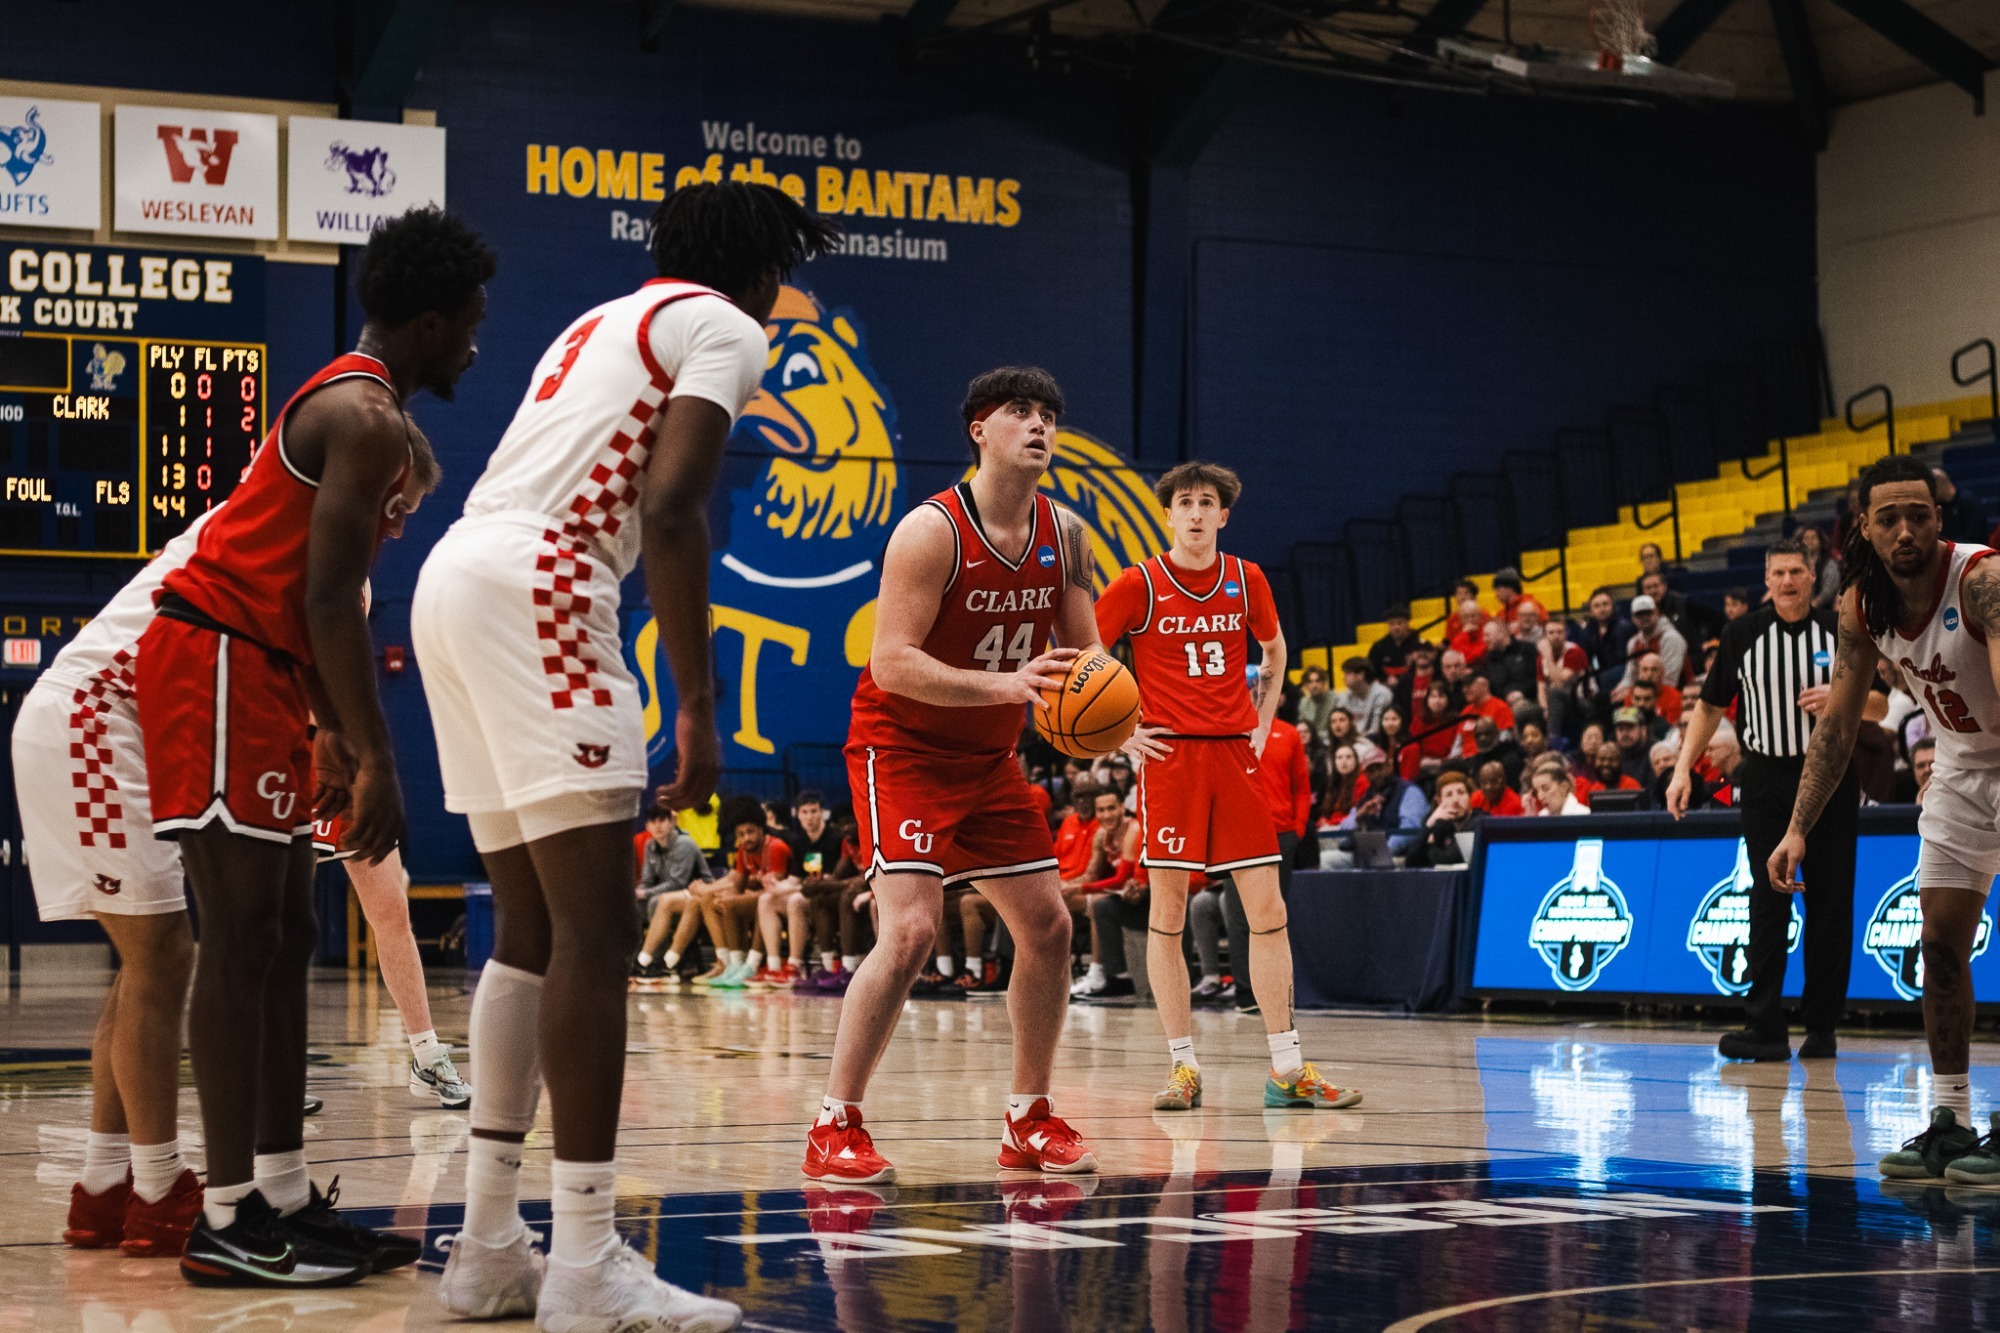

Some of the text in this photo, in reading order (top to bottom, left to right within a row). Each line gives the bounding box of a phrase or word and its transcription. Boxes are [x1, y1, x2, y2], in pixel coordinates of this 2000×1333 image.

[702, 120, 862, 160] Welcome to
[526, 144, 665, 201] HOME
[816, 166, 1021, 227] BANTAMS
[0, 193, 49, 216] UFTS
[142, 200, 255, 226] WESLEYAN
[317, 210, 387, 238] WILLIA
[9, 248, 233, 303] COLLEGE
[34, 298, 138, 330] COURT
[150, 345, 259, 372] PLY FL PTS
[535, 314, 604, 402] 3
[171, 372, 255, 402] 0 0 0
[53, 395, 110, 421] CLARK
[241, 405, 255, 432] 2
[6, 477, 130, 505] FOUL FLS
[162, 463, 212, 491] 13 0
[152, 494, 186, 518] 44
[965, 585, 1056, 613] CLARK
[1158, 612, 1242, 635] CLARK
[11, 640, 37, 662] EXIT
[972, 622, 1036, 672] 44
[1183, 640, 1228, 678] 13
[1069, 652, 1114, 694] Wilson
[1924, 684, 1983, 733] 12
[256, 770, 296, 820] CU
[898, 819, 935, 854] CU
[1157, 826, 1187, 855] CU
